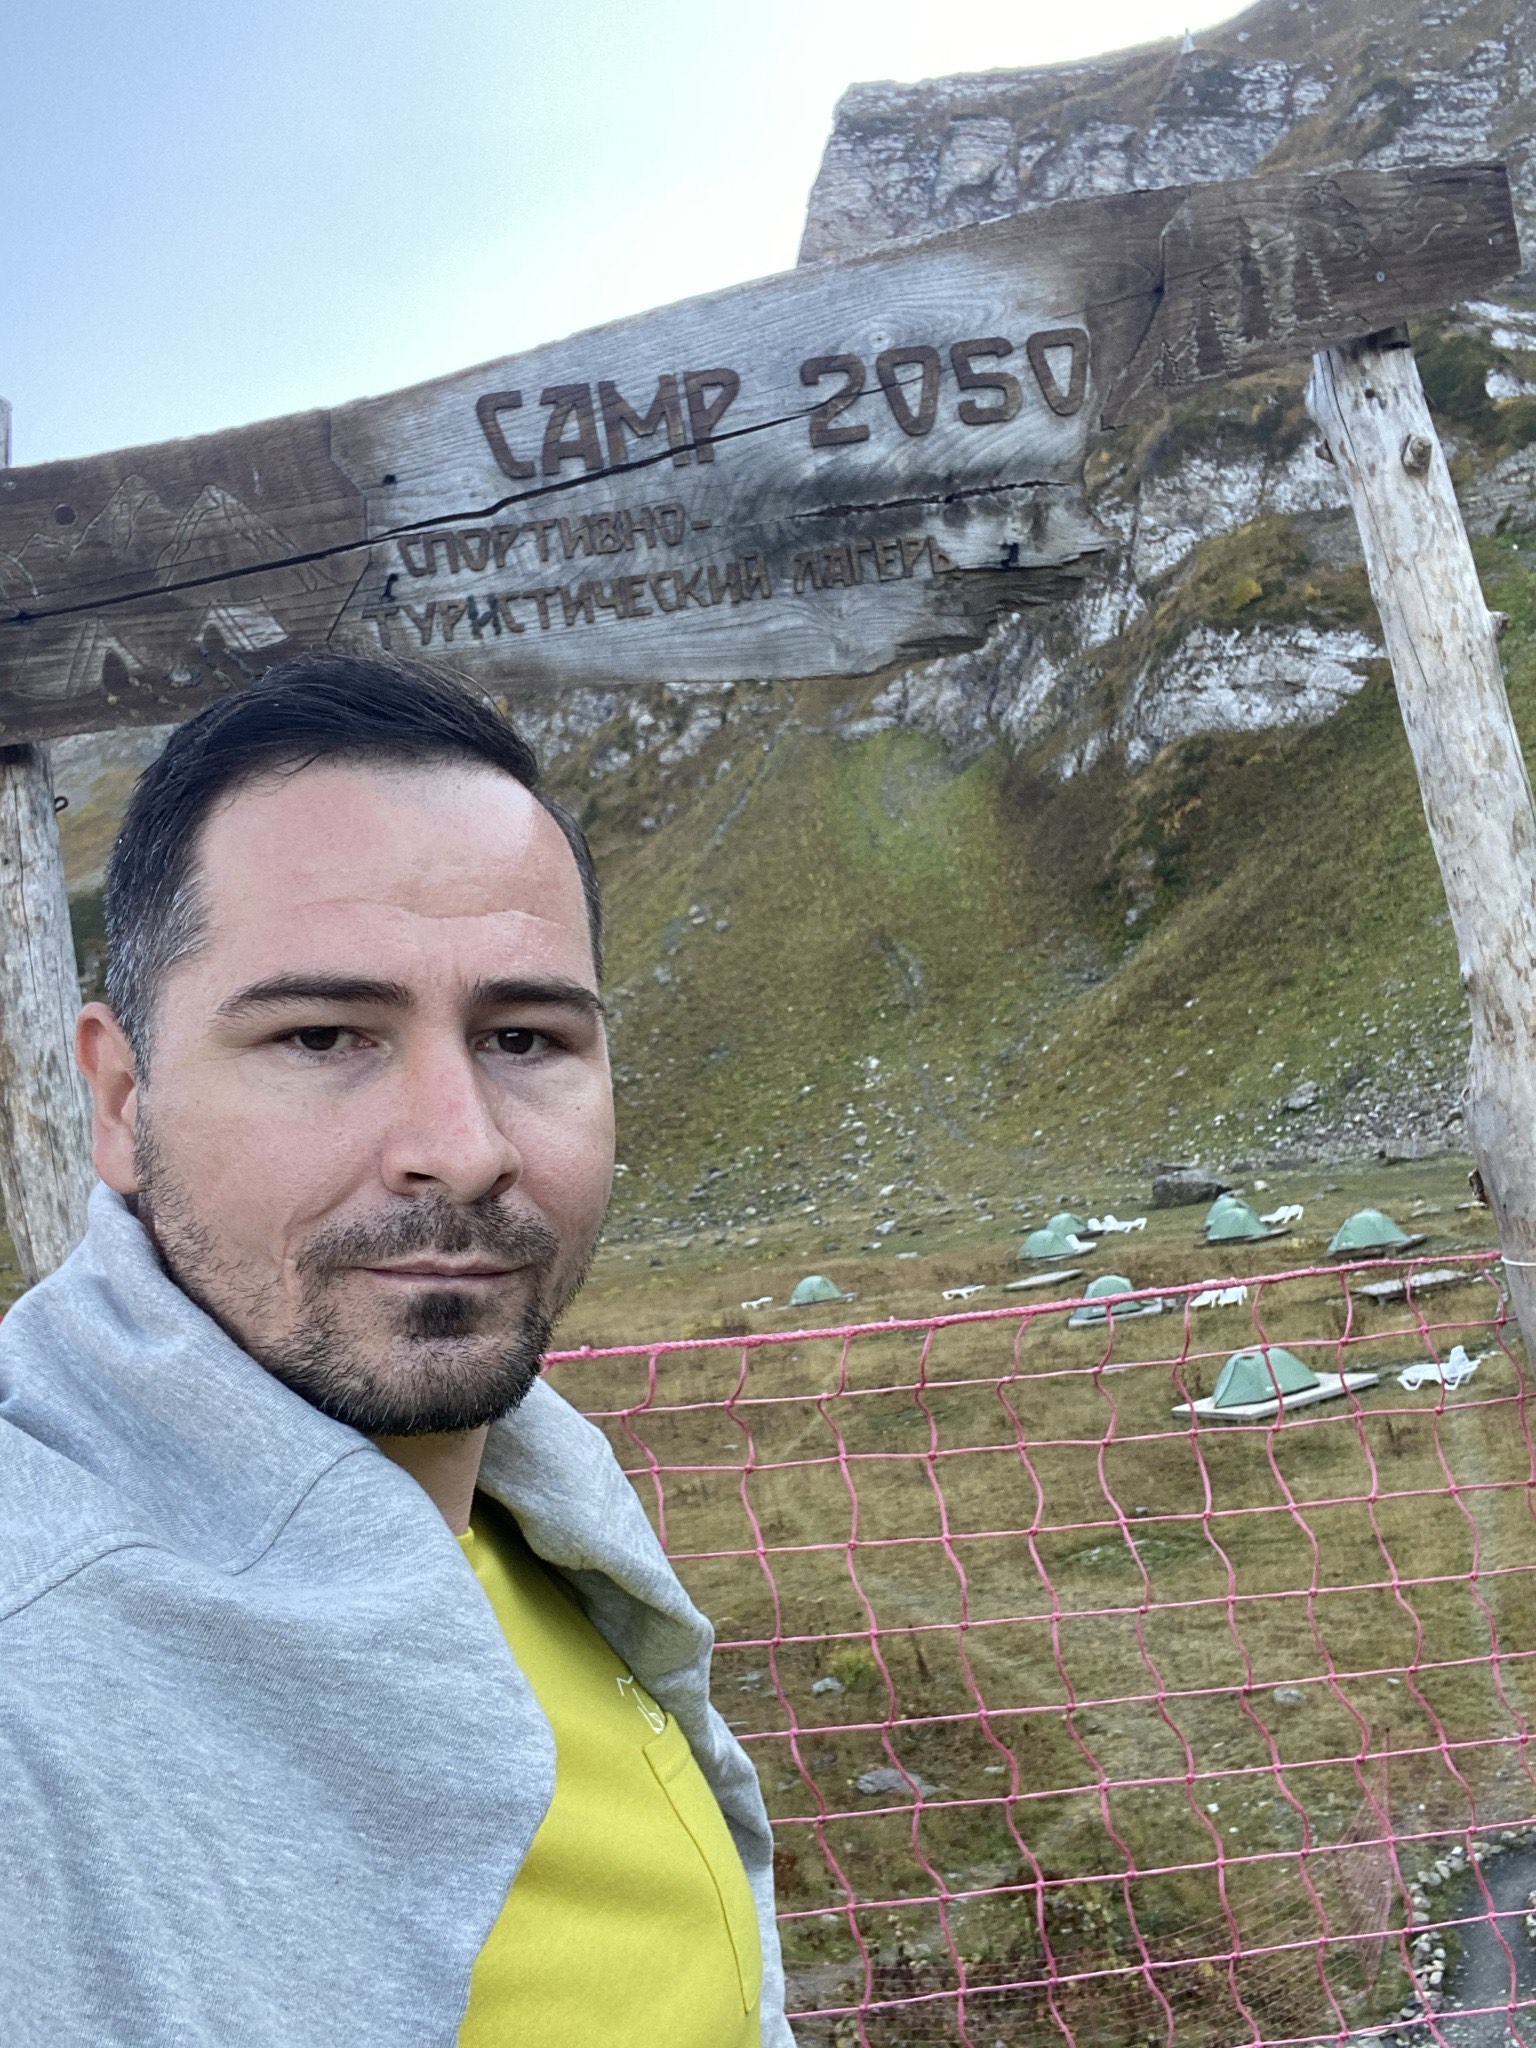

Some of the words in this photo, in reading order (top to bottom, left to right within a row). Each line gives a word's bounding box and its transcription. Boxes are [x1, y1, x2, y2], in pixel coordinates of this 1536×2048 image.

[475, 367, 741, 479] CAMP
[801, 328, 1090, 448] 2050
[362, 549, 772, 650] ТУРИСТИЧЕСКИЙ
[794, 535, 959, 594] ЛАГЕРЬ
[397, 502, 712, 578] СПОРТИВНО-
